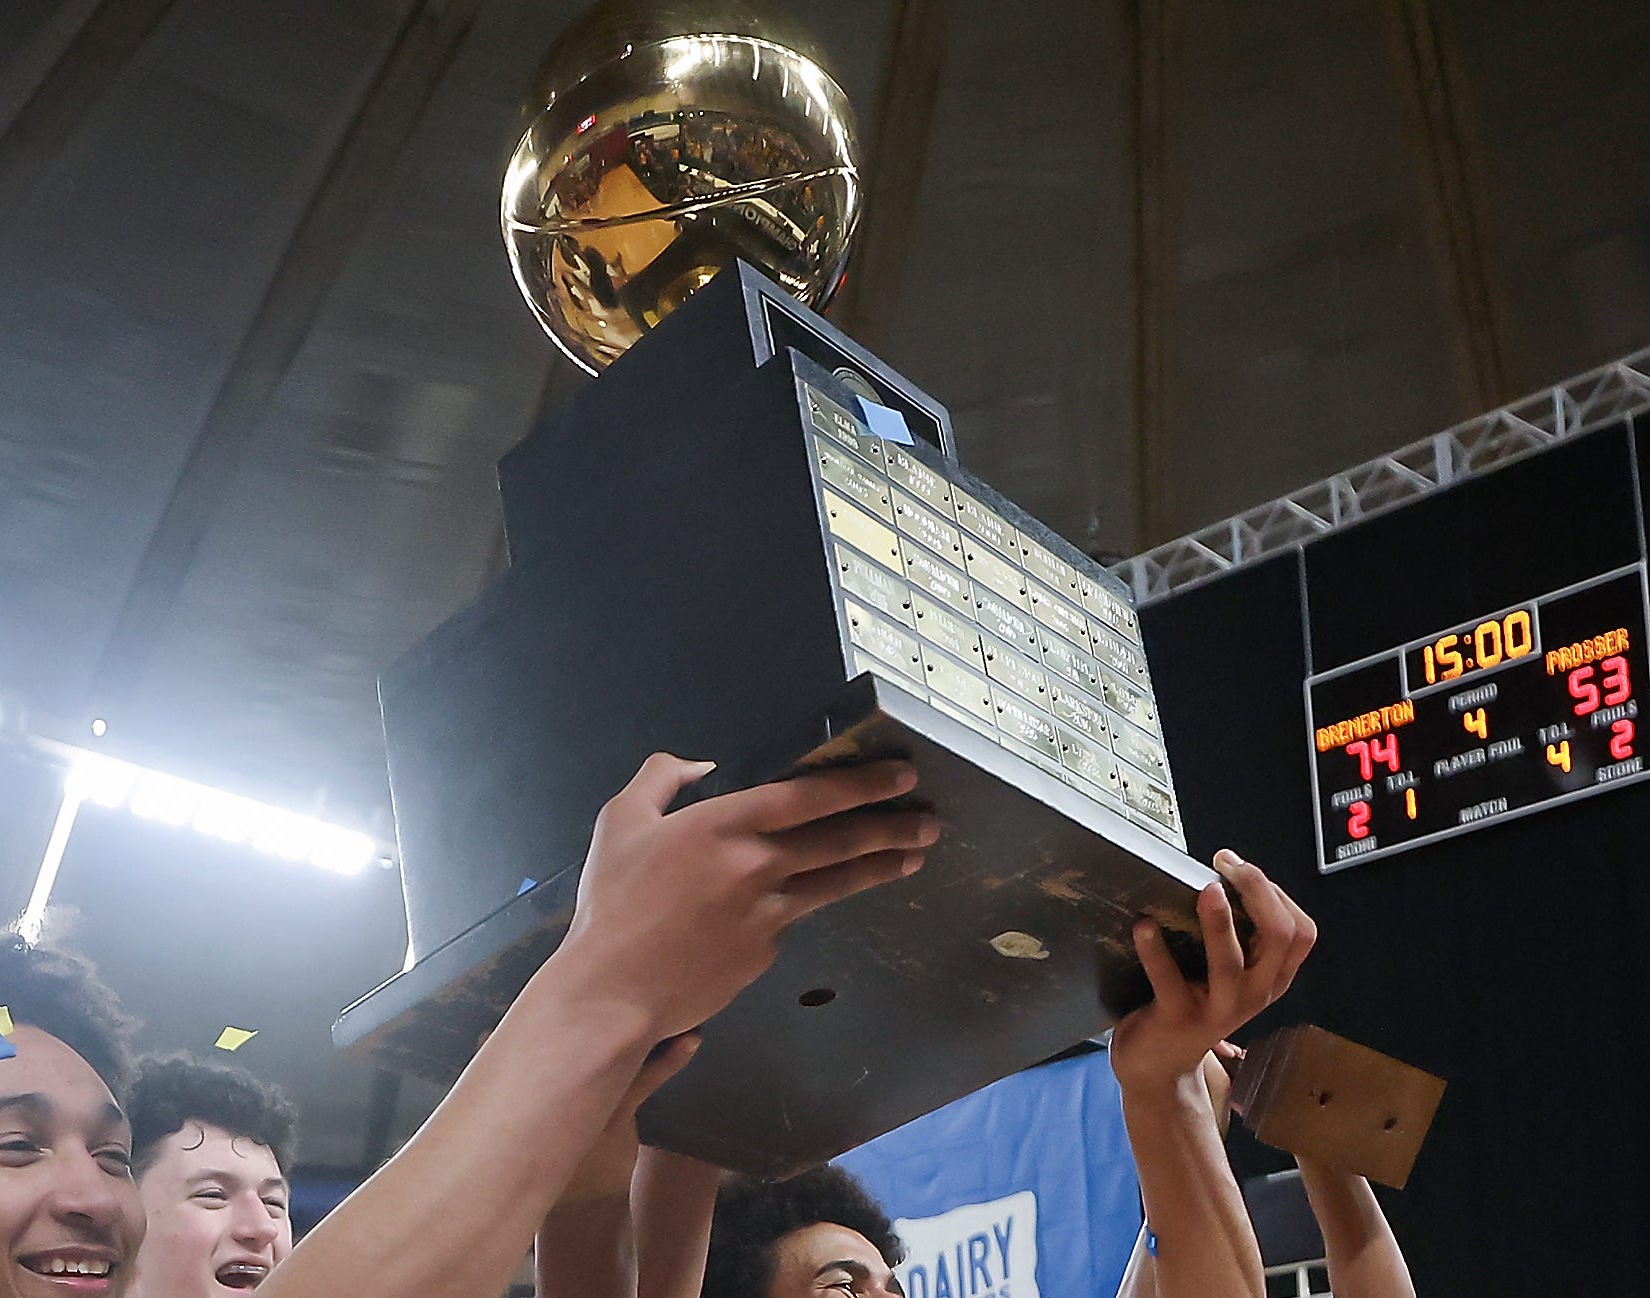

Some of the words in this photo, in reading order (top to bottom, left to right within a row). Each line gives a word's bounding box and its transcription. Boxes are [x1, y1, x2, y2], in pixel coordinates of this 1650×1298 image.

[1423, 610, 1532, 684] 15:00
[1568, 656, 1632, 717] 53
[1316, 698, 1415, 752] BREMERTON
[1463, 707, 1488, 739] 4
[1610, 719, 1635, 759] 2
[1345, 733, 1400, 781] 74
[1546, 740, 1572, 773] 4
[1347, 801, 1372, 839] 2
[1406, 788, 1418, 820] 1
